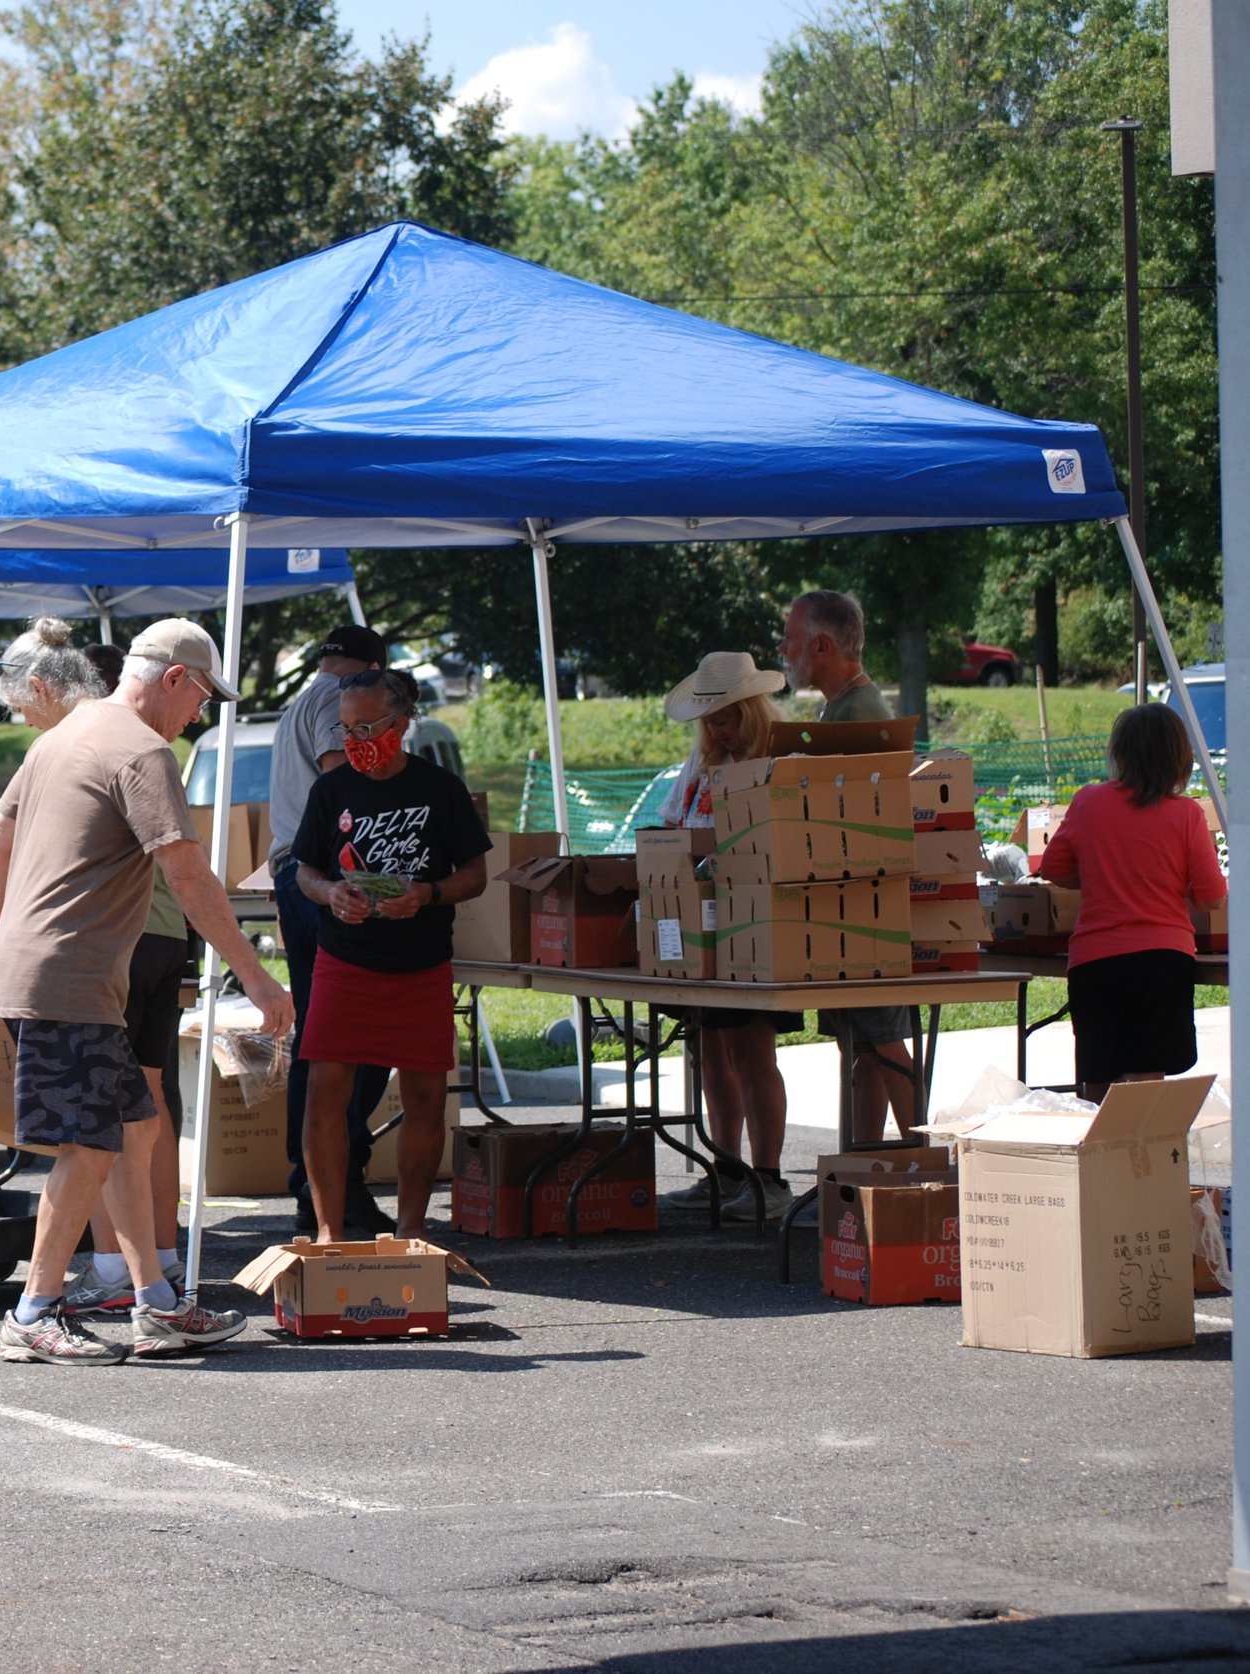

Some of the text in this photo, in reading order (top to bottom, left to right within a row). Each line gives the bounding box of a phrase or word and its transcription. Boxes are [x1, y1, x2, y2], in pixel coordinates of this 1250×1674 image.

[353, 805, 431, 844] DELTA
[366, 832, 421, 863] Girls
[964, 1191, 1066, 1208] COLDWATER CREEK LARGE BAGS
[551, 1207, 611, 1223] Brccoli
[1158, 1229, 1171, 1240] KGS
[831, 1239, 864, 1263] organic
[1158, 1242, 1171, 1253] KGS
[325, 1262, 422, 1273] world's finest avocados
[834, 1265, 860, 1281] Broccoli
[344, 1306, 408, 1321] Mission
